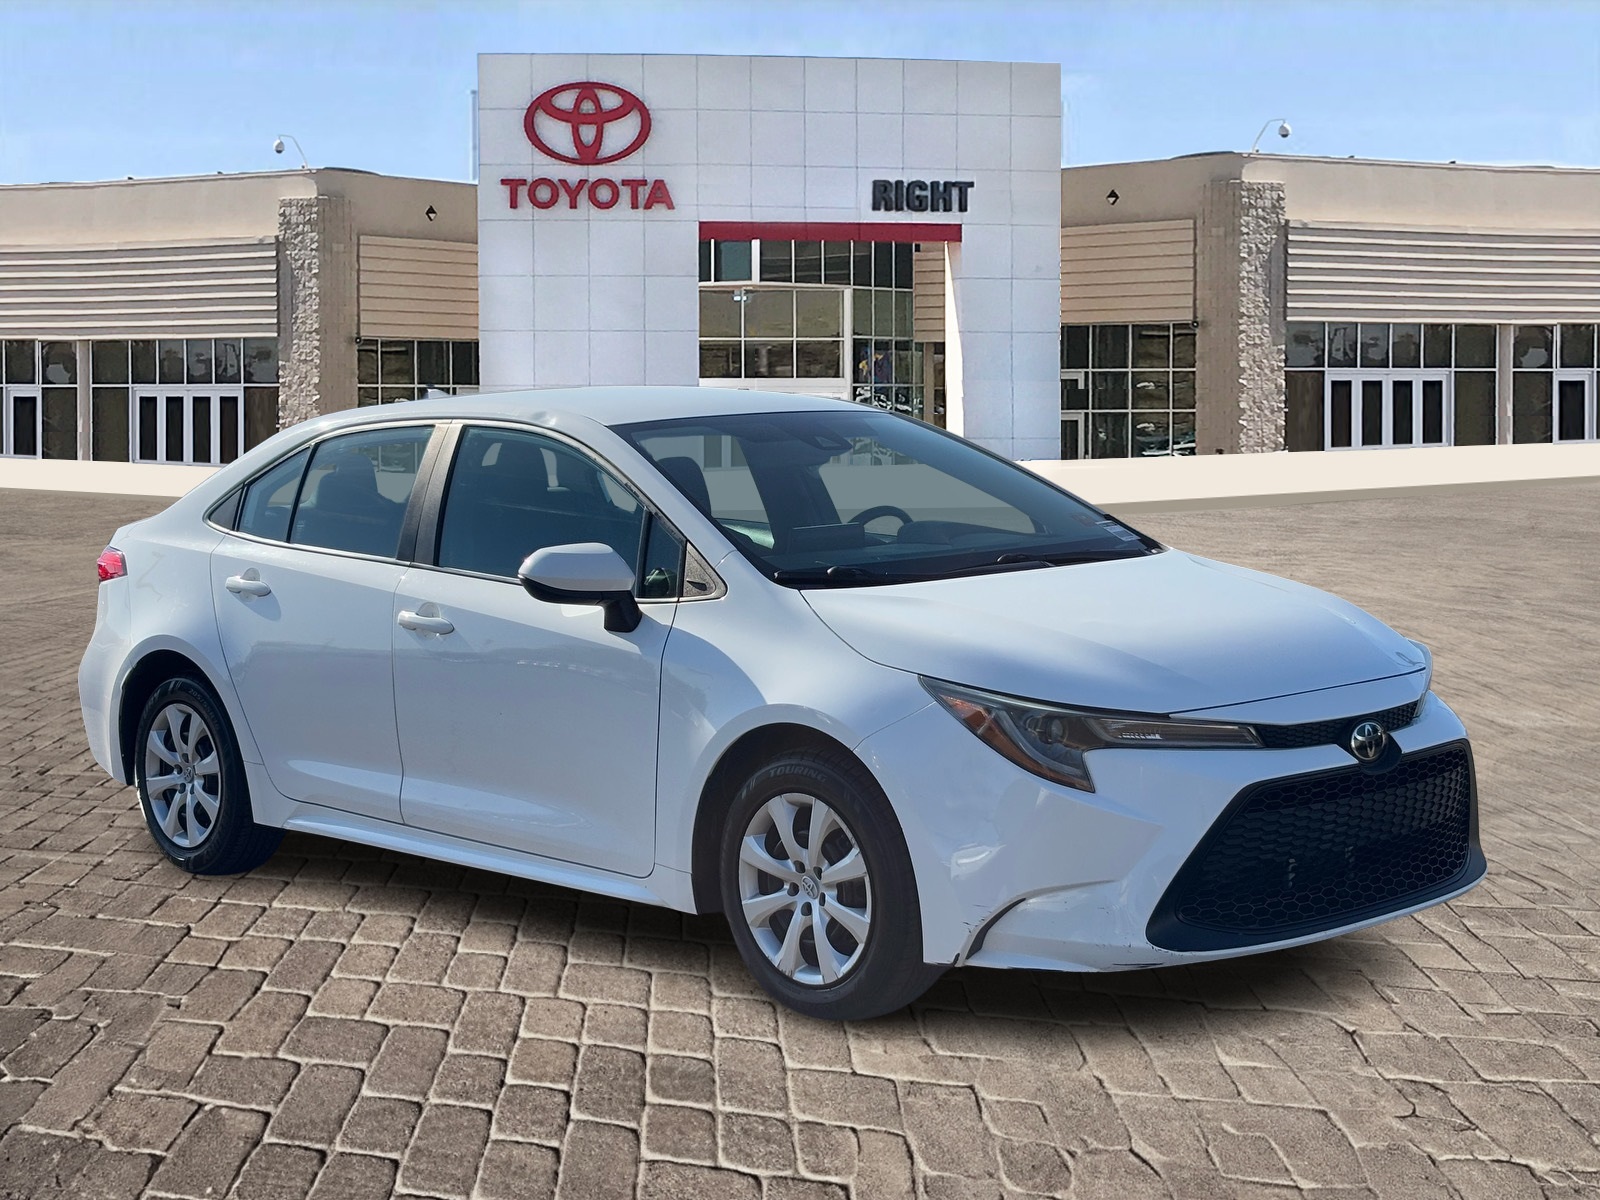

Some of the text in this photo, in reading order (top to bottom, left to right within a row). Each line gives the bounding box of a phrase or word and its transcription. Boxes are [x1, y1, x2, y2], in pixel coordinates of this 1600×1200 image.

[500, 178, 675, 210] TOYOTA
[872, 179, 975, 212] RIGHT
[768, 765, 828, 783] TOURING
